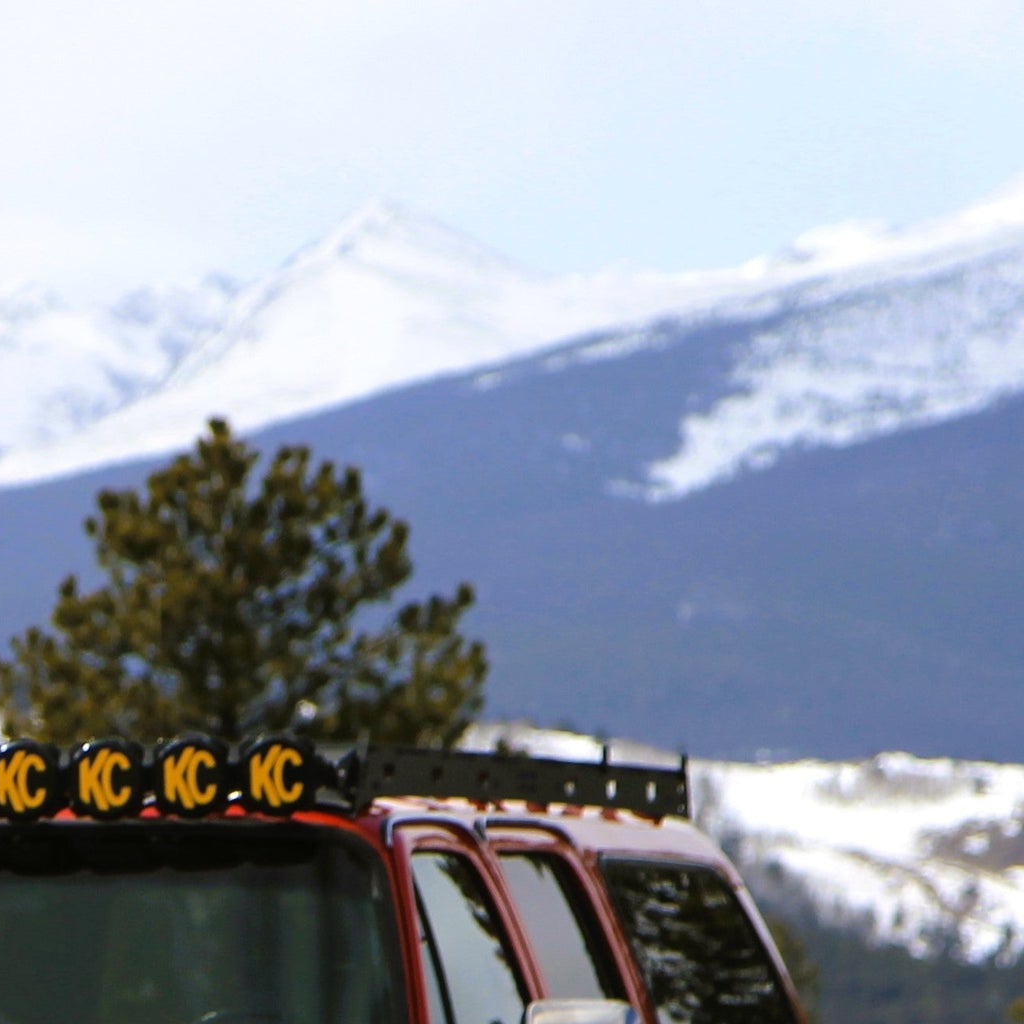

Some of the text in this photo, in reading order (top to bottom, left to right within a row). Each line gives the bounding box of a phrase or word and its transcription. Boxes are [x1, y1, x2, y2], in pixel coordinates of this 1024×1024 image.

[78, 747, 132, 812] KC
[162, 745, 218, 810] KC
[249, 744, 304, 808] KC
